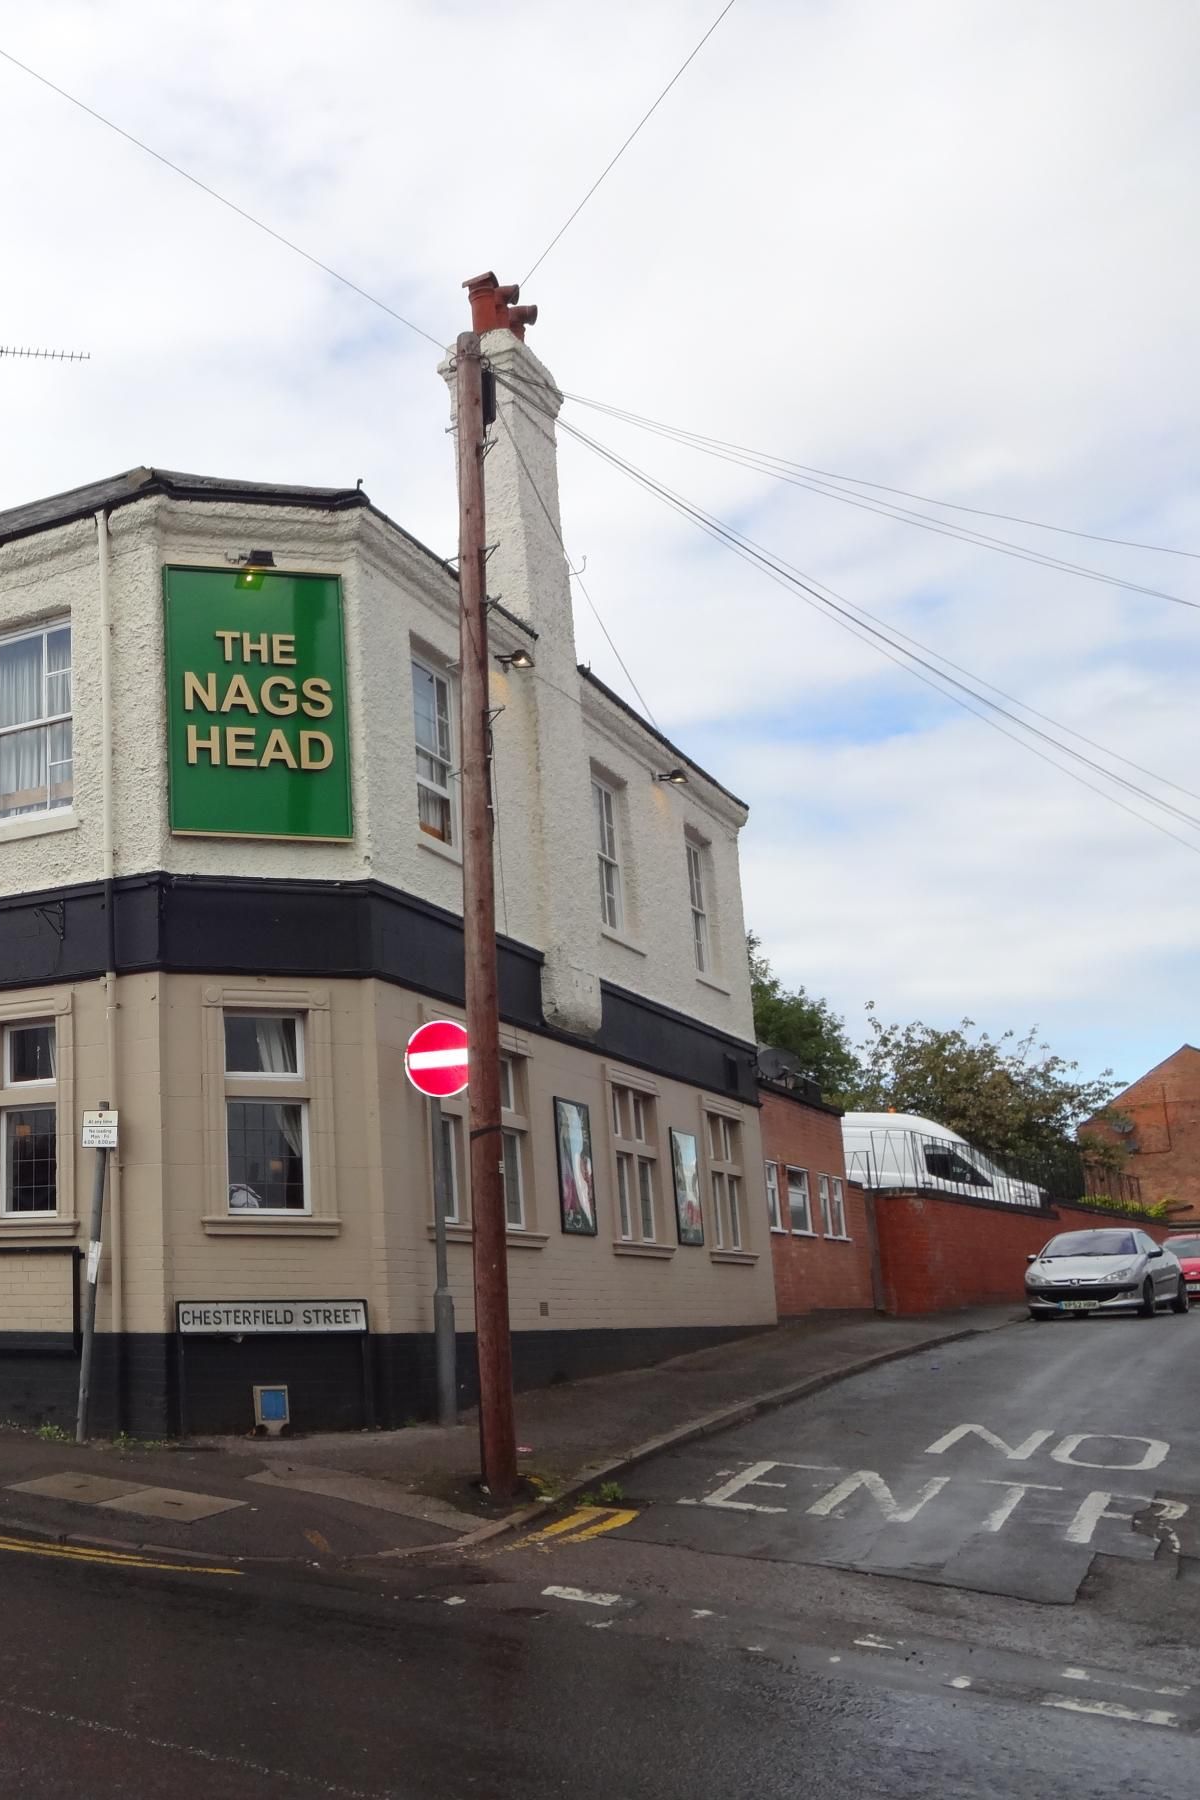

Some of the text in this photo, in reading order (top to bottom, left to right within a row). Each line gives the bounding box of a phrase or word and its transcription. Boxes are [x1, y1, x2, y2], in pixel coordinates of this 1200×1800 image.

[215, 630, 297, 665] THE
[184, 671, 334, 718] NAGS
[186, 724, 335, 770] HEAD
[181, 1308, 362, 1326] CHESTERFIELD STREET
[924, 1423, 1171, 1471] NO
[677, 1460, 1190, 1553] ENTR
